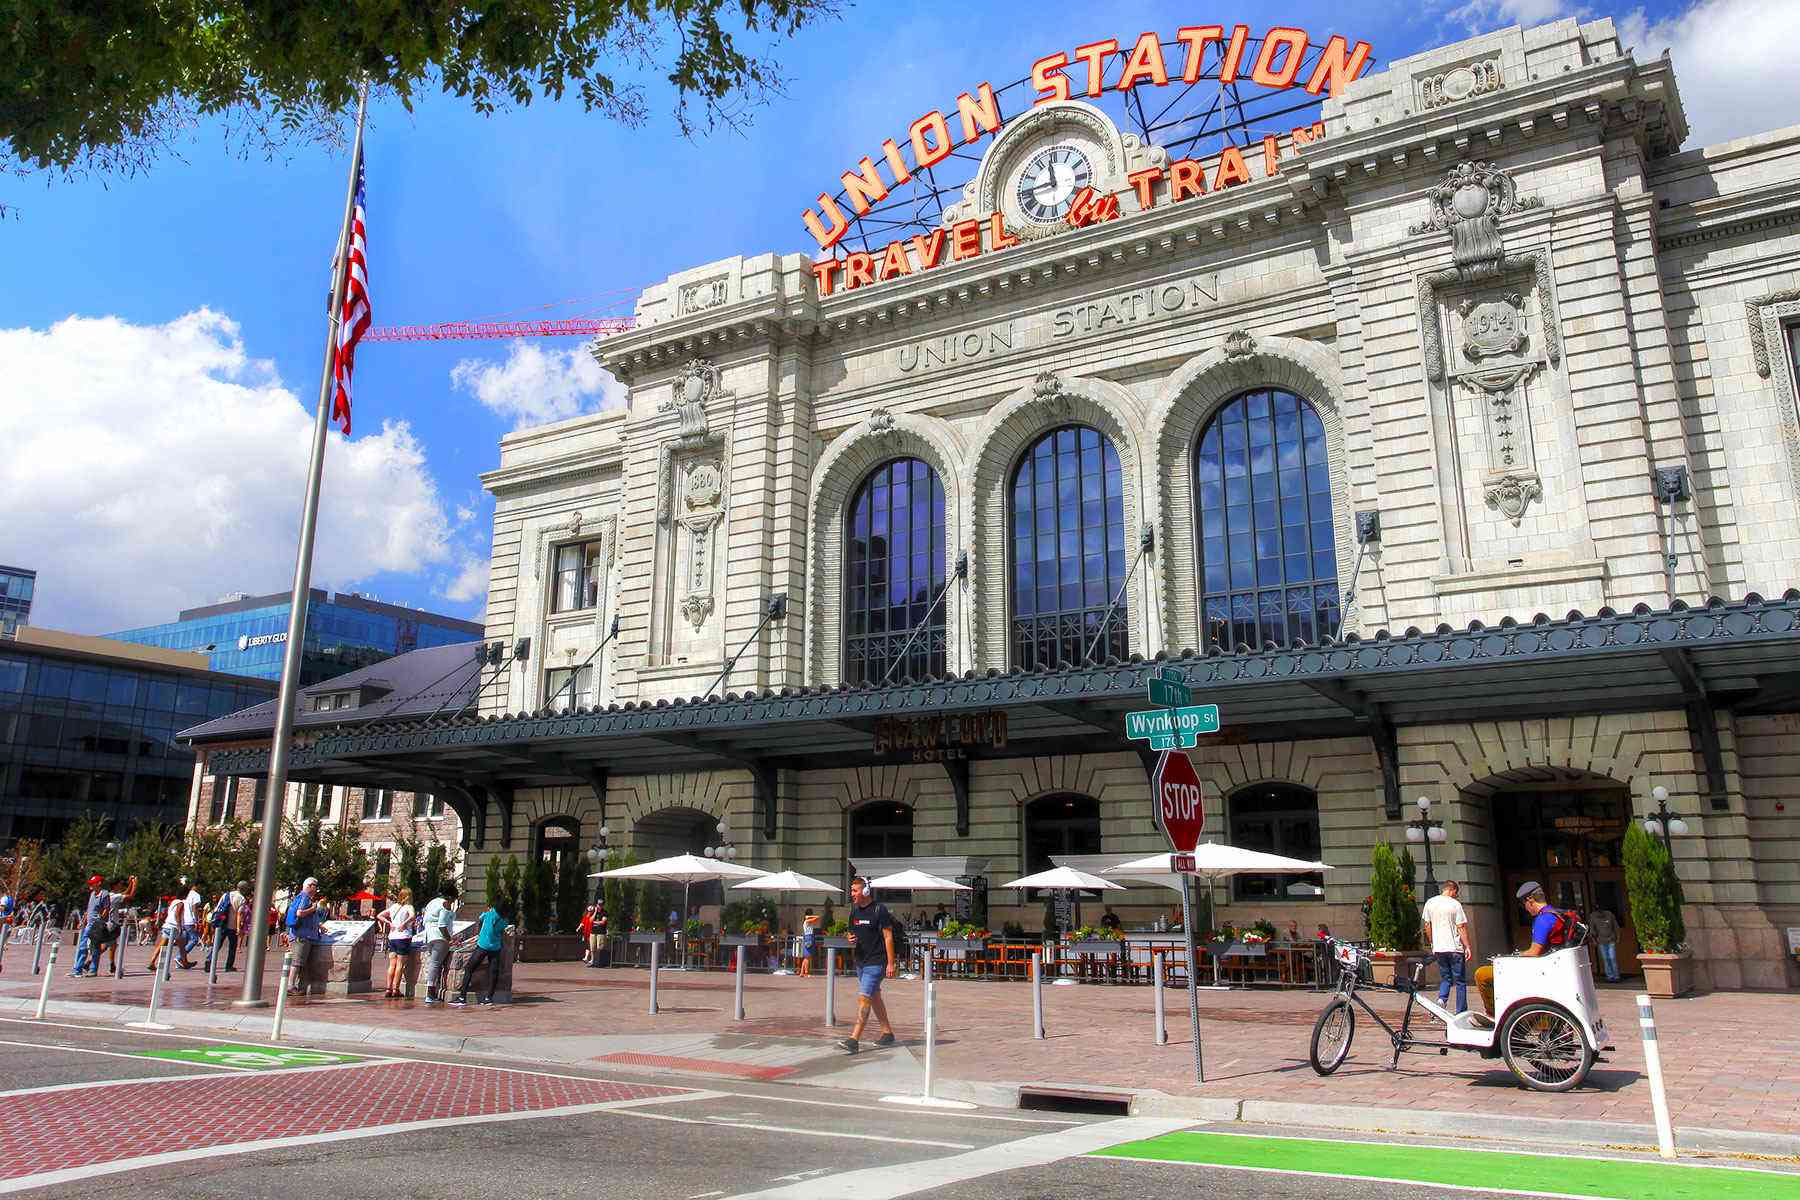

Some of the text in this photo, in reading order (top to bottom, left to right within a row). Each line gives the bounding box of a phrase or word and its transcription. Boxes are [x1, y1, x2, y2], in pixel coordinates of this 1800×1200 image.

[802, 24, 1374, 249] UNION STATION
[812, 211, 1022, 297] TRAVEL
[1064, 184, 1120, 229] by
[896, 271, 1223, 372] UNION STATION
[1471, 312, 1514, 337] 1914
[1131, 713, 1214, 734] Wynkoop St
[1164, 783, 1200, 820] STOP
